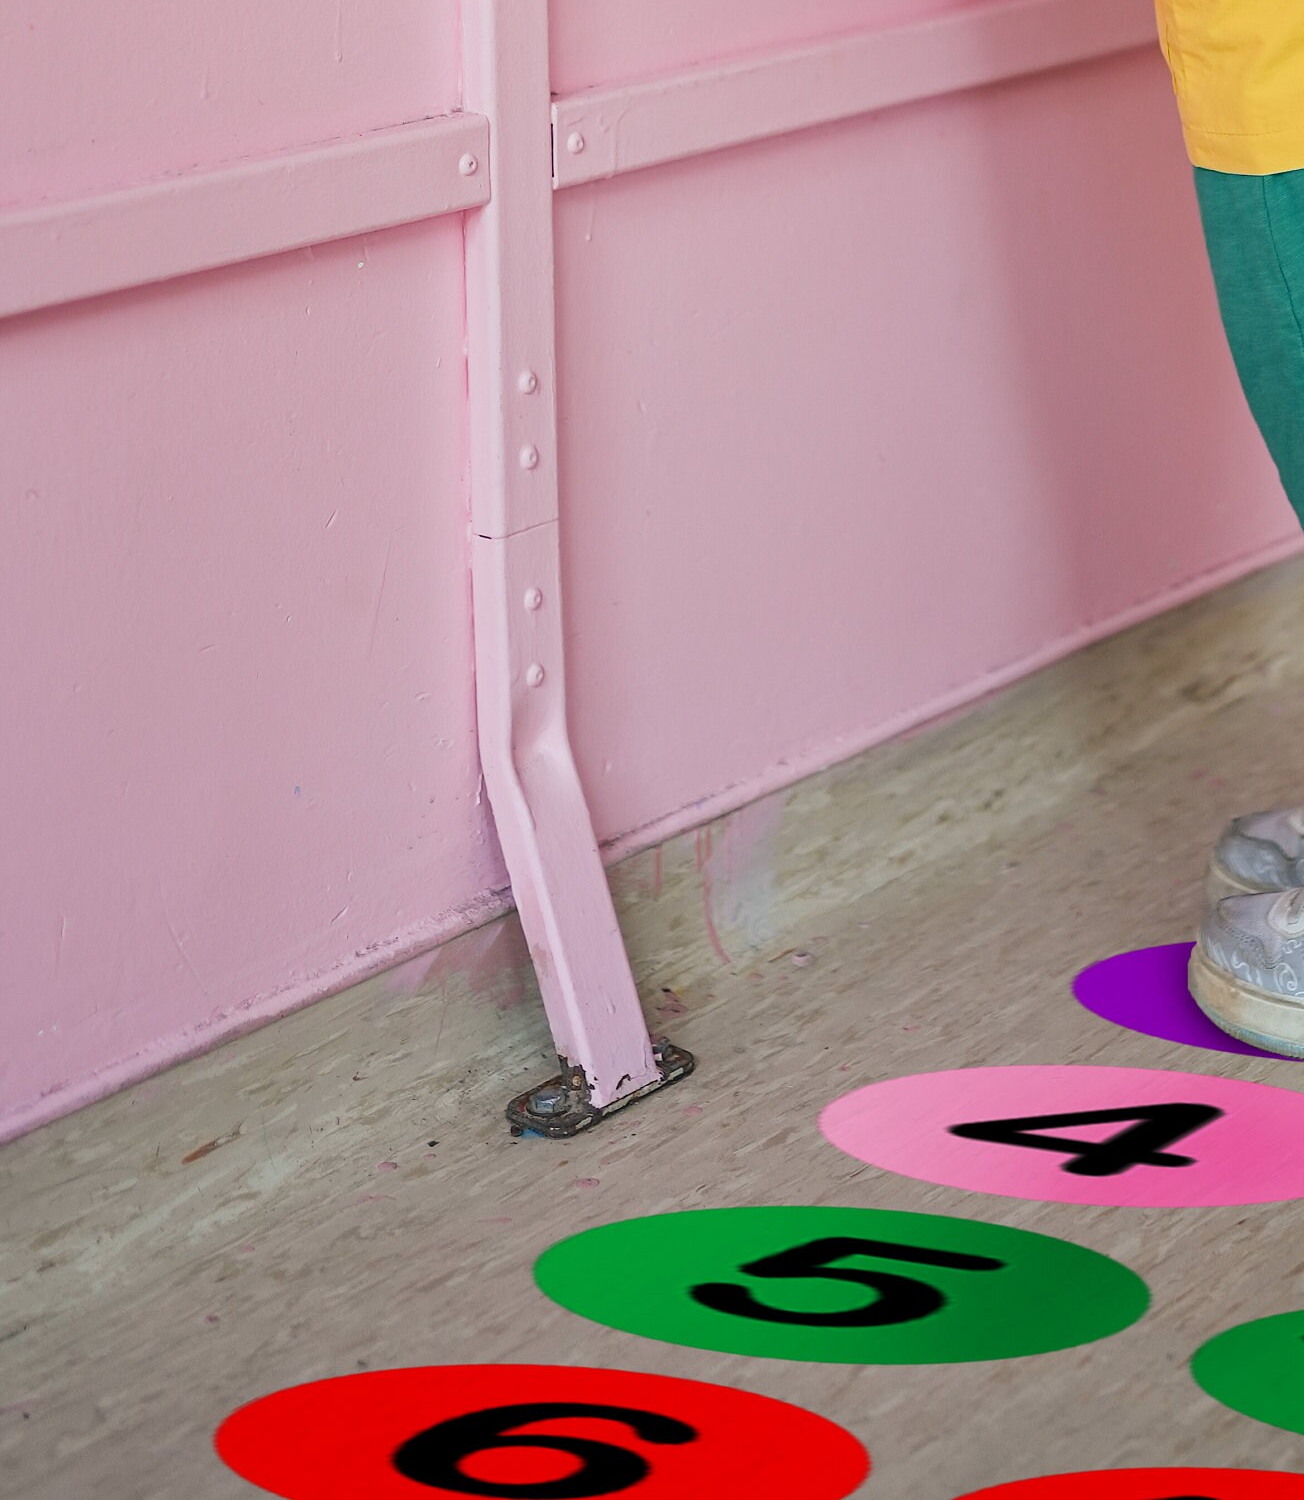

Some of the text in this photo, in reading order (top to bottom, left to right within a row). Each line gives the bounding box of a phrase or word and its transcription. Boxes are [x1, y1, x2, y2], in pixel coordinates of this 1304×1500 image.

[949, 1102, 1225, 1177] 4
[686, 1236, 1008, 1328] 5
[390, 1402, 699, 1500] 6
